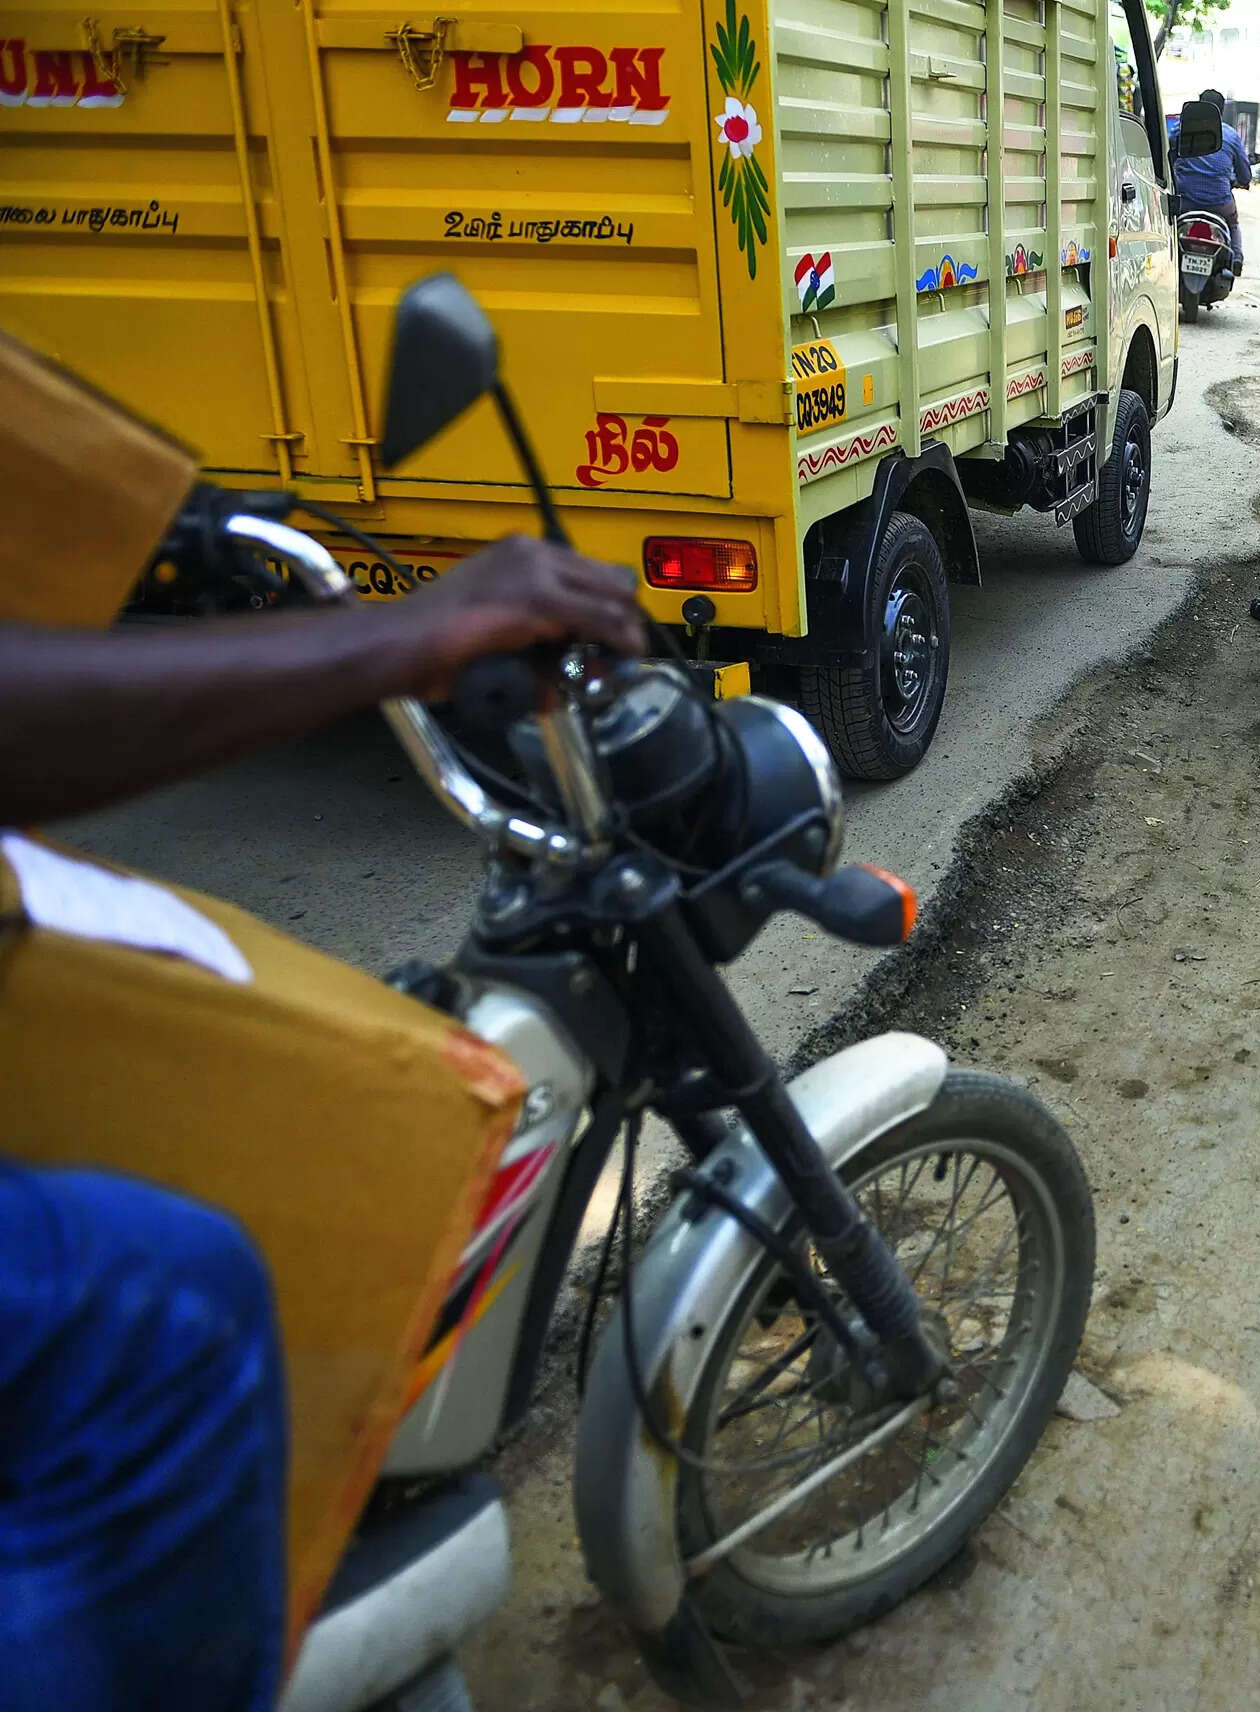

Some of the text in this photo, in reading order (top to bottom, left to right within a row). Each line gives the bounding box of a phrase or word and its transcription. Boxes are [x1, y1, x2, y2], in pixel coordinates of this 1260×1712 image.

[449, 45, 671, 111] HORN
[62, 200, 178, 234] பாதுகாப்பு
[444, 212, 634, 244] உயிர் பாதுகாப்பு
[576, 412, 679, 487] நில்
